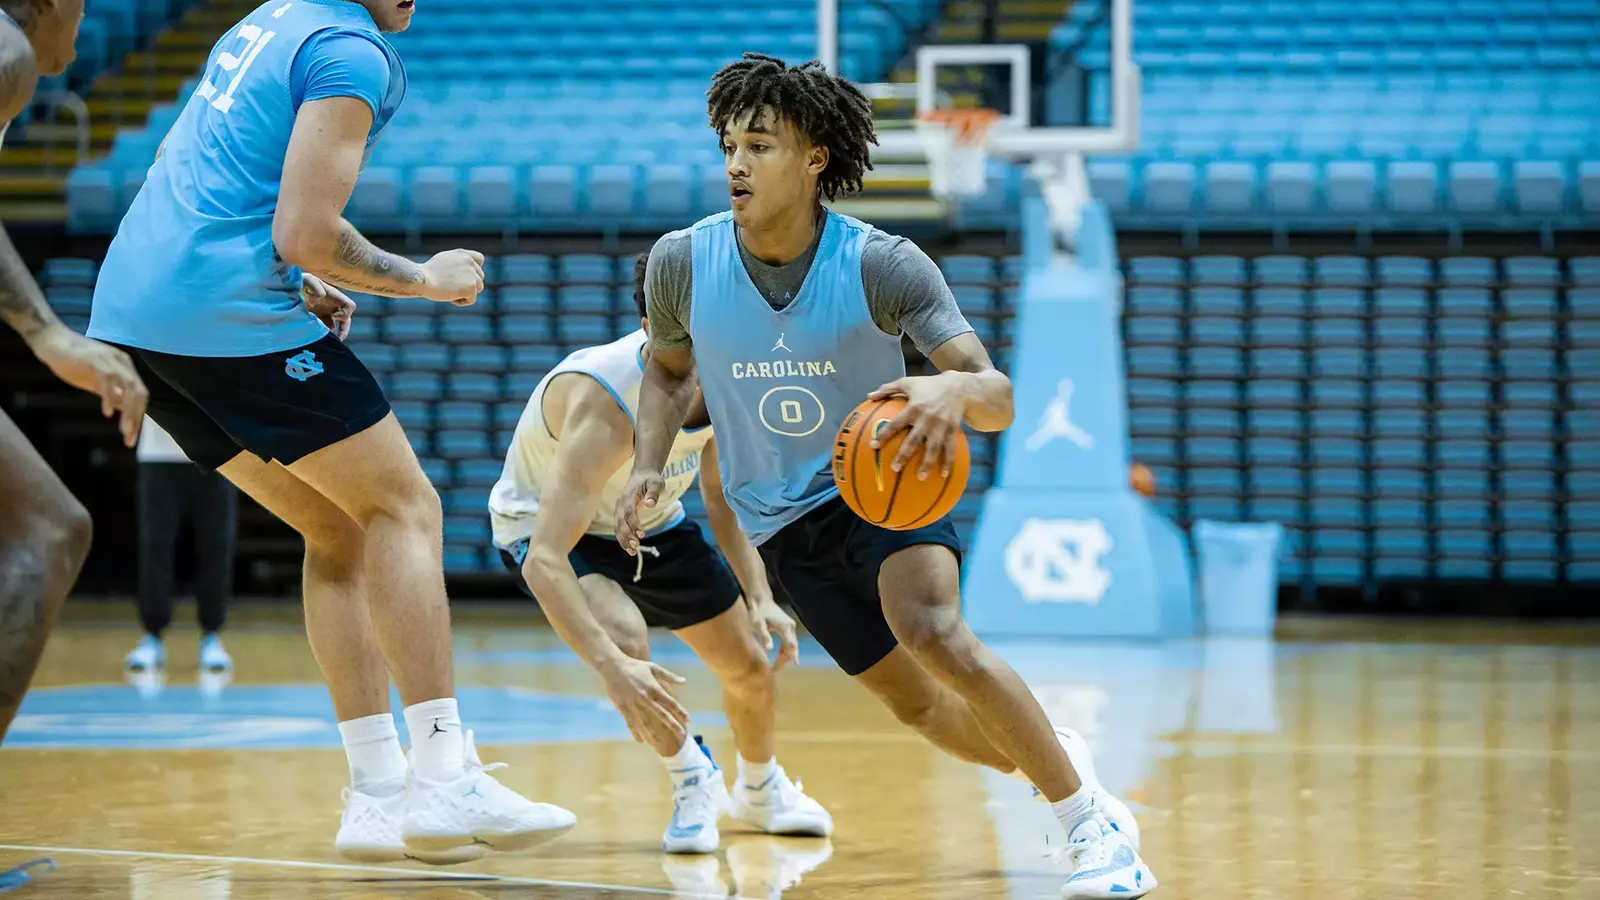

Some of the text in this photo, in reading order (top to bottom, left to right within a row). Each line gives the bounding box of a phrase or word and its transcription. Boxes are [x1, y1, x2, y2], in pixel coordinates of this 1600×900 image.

[196, 24, 276, 114] 21
[731, 360, 836, 379] CAROLINA
[781, 400, 803, 423] 0
